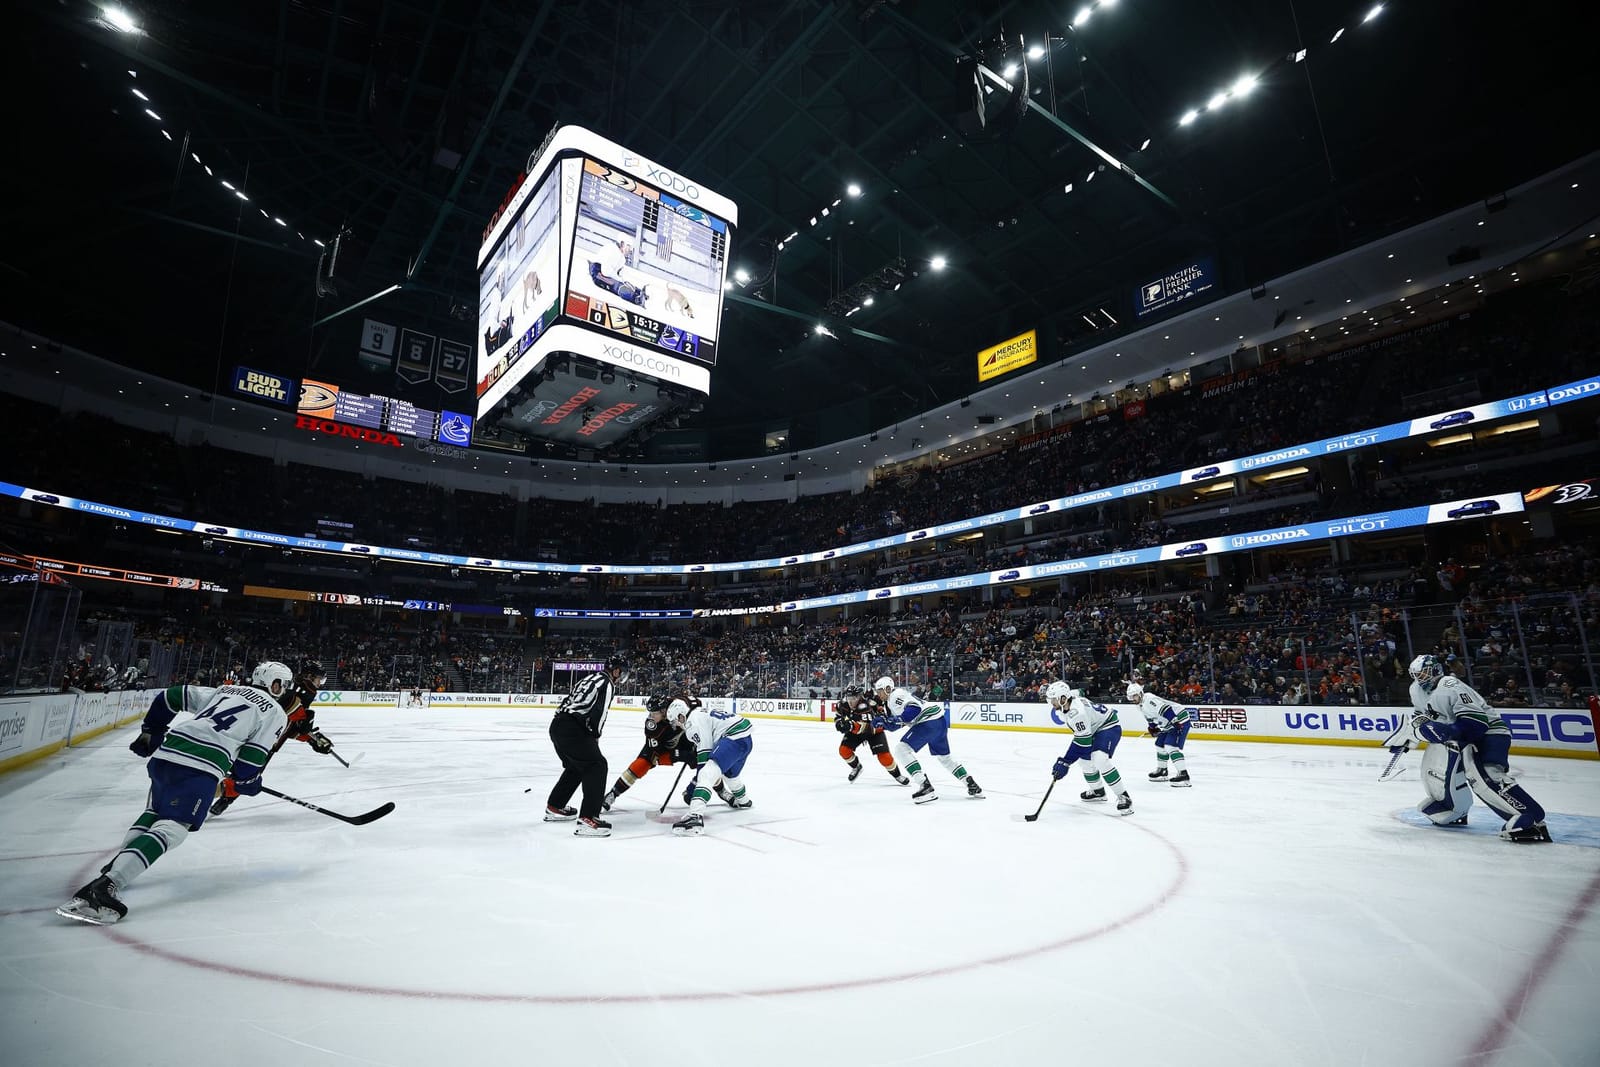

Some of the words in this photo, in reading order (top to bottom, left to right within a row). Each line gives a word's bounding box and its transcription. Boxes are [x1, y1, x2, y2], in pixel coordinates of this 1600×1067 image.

[647, 165, 699, 200] XODO
[1165, 264, 1199, 284] PACIFIC
[1166, 270, 1204, 290] PREMIER
[1166, 282, 1191, 297] BANK
[594, 312, 602, 321] 0
[633, 315, 659, 332] 15:12
[372, 333, 384, 350] 9
[685, 344, 692, 353] 2
[997, 337, 1032, 356] MERCURY
[410, 344, 423, 361] 8
[602, 343, 681, 377] xodo.com
[997, 343, 1033, 361] INSURANCE
[443, 353, 466, 370] 27
[247, 371, 281, 389] BUD
[238, 379, 286, 400] LIGHT
[370, 393, 389, 402] SHOTS
[399, 400, 414, 408] GOAL
[541, 386, 601, 424] HONDA
[576, 402, 638, 435] HONDA
[295, 415, 402, 448] HONDA
[1254, 447, 1311, 465] HONDA
[1326, 434, 1378, 453] PILOT
[1074, 491, 1113, 504] HONDA
[1122, 481, 1159, 496] PILOT
[90, 504, 131, 518] HONDA
[141, 516, 177, 527] PILOT
[944, 521, 973, 532] HONDA
[1246, 528, 1310, 545] HONDA
[1327, 518, 1389, 536] PILOT
[253, 532, 289, 543] HONDA
[297, 540, 328, 548] PILOT
[1046, 561, 1088, 573] HONDA
[1099, 555, 1139, 568] PILOT
[909, 583, 938, 593] HONDA
[946, 578, 974, 589] PILOT
[363, 597, 384, 606] 15:12
[711, 607, 748, 616] ANAHEIM
[749, 606, 774, 614] DUCKS
[569, 663, 596, 671] NEXEN
[314, 691, 342, 702] OX
[1459, 693, 1473, 704] 60
[749, 701, 775, 713] XODO
[778, 701, 806, 711] BREWERY
[980, 704, 997, 713] OC
[980, 713, 1023, 723] SOLAR
[1075, 721, 1086, 731] 86
[1285, 712, 1329, 730] UCI
[1339, 714, 1398, 732] Heal
[1231, 723, 1248, 731] INC.
[1501, 713, 1595, 743] EIC
